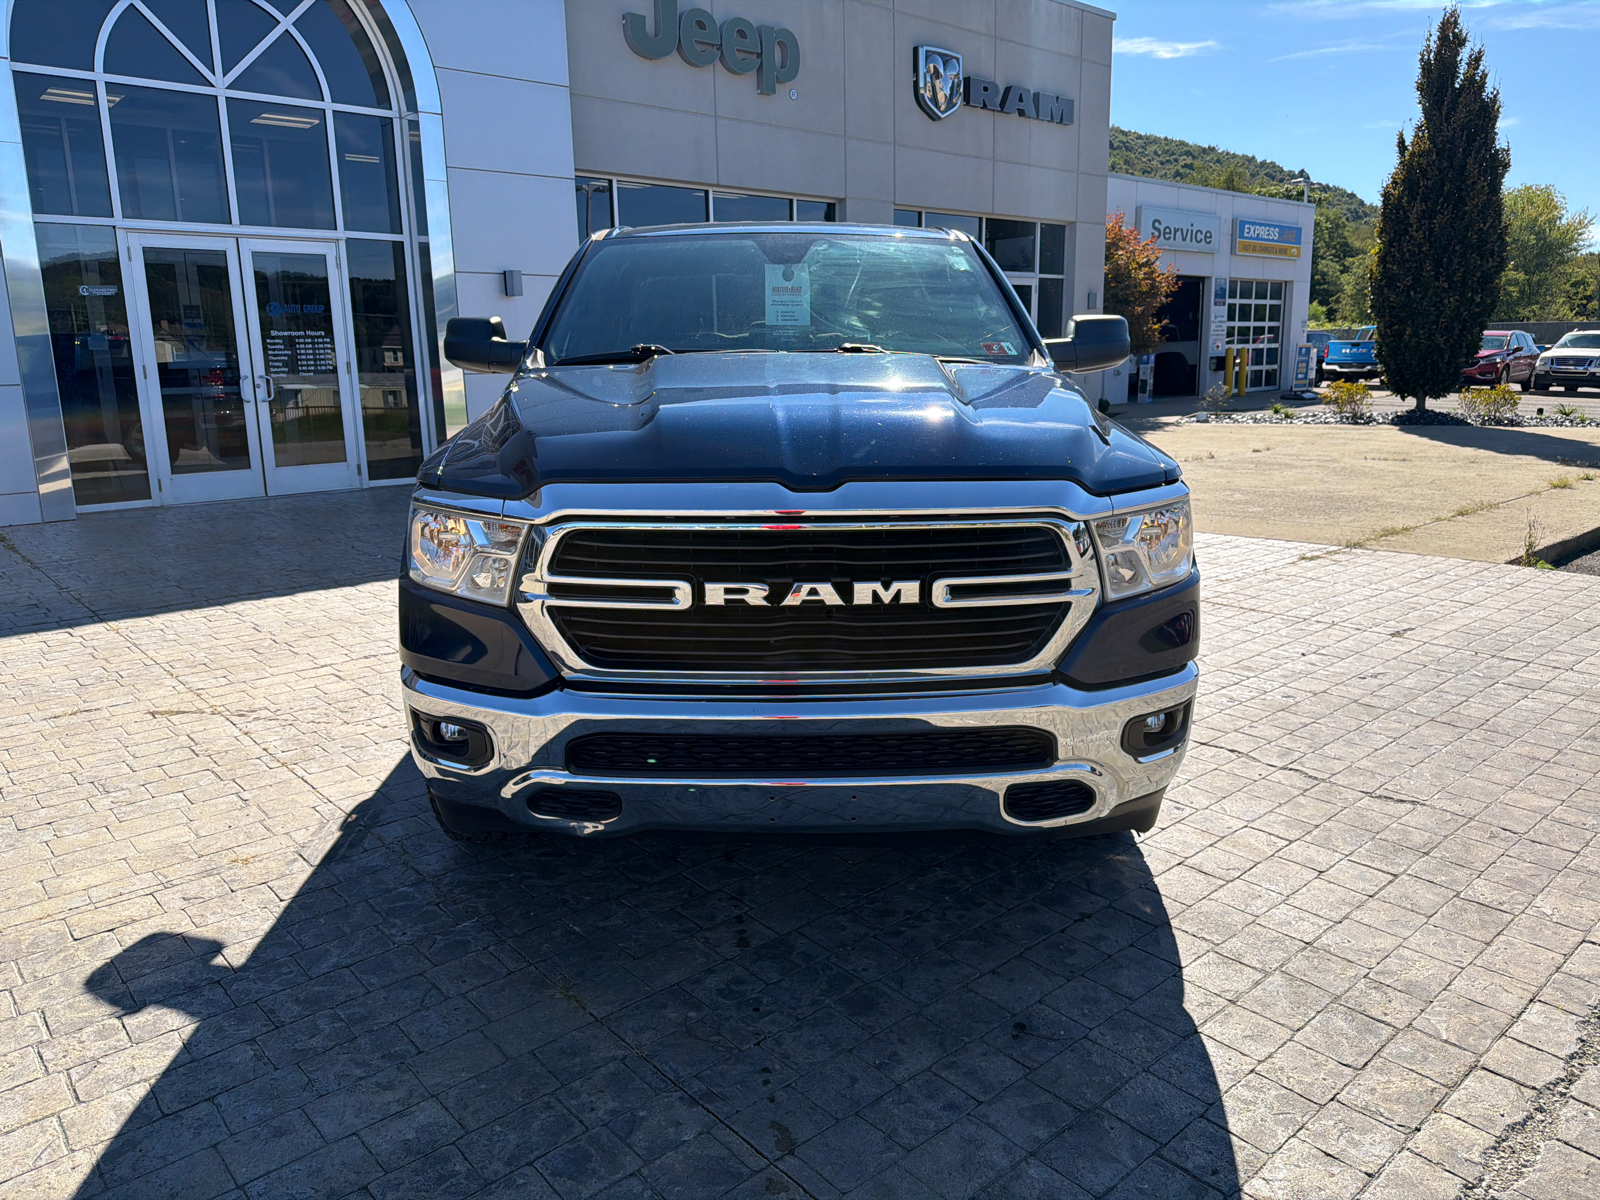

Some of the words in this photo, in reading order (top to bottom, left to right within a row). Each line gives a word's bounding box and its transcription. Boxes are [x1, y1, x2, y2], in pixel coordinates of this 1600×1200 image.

[622, 0, 800, 96] Jeep
[963, 76, 1075, 126] RAM
[1151, 218, 1213, 245] Service
[1243, 224, 1279, 241] EXPRESS
[284, 304, 301, 314] AUTO
[303, 304, 325, 314] GROUP
[704, 580, 921, 606] RAM
